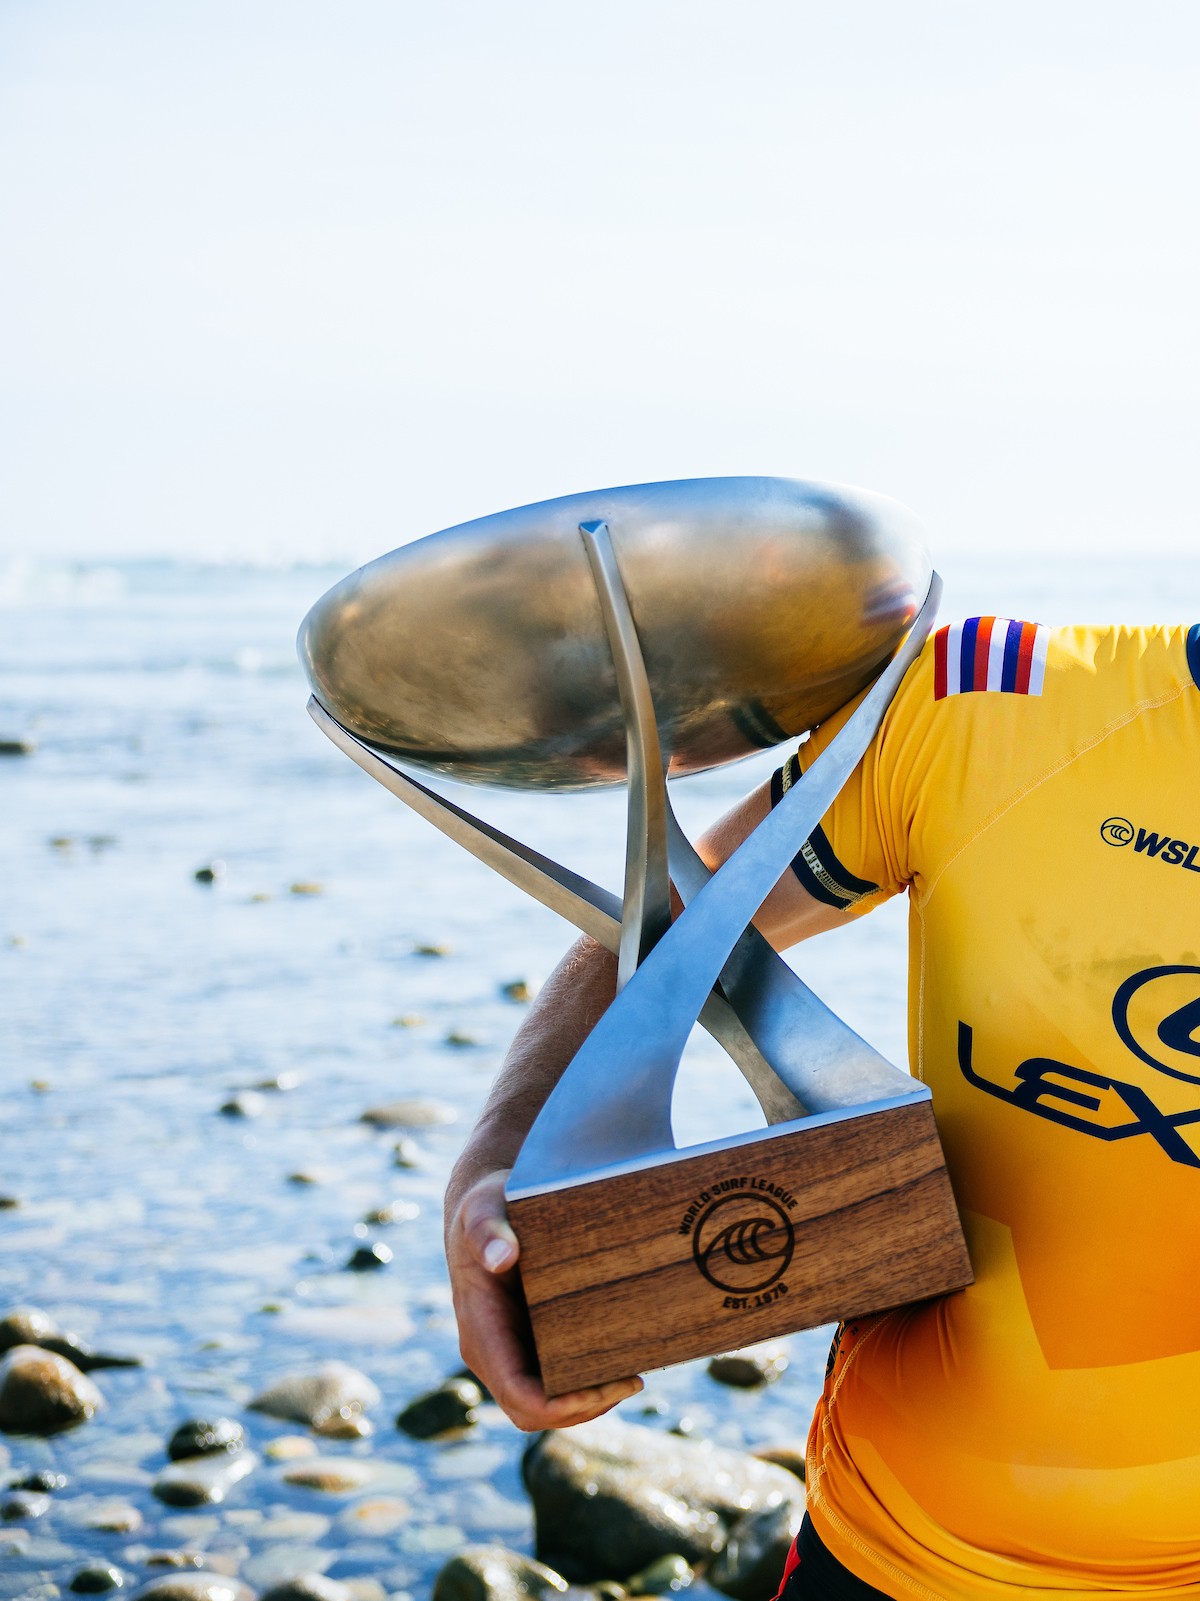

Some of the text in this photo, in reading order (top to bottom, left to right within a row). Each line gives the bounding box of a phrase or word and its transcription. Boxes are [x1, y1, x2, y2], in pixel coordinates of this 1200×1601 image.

[678, 1177, 799, 1235] WORLD SURF LEAGUE
[722, 1296, 752, 1309] EST.
